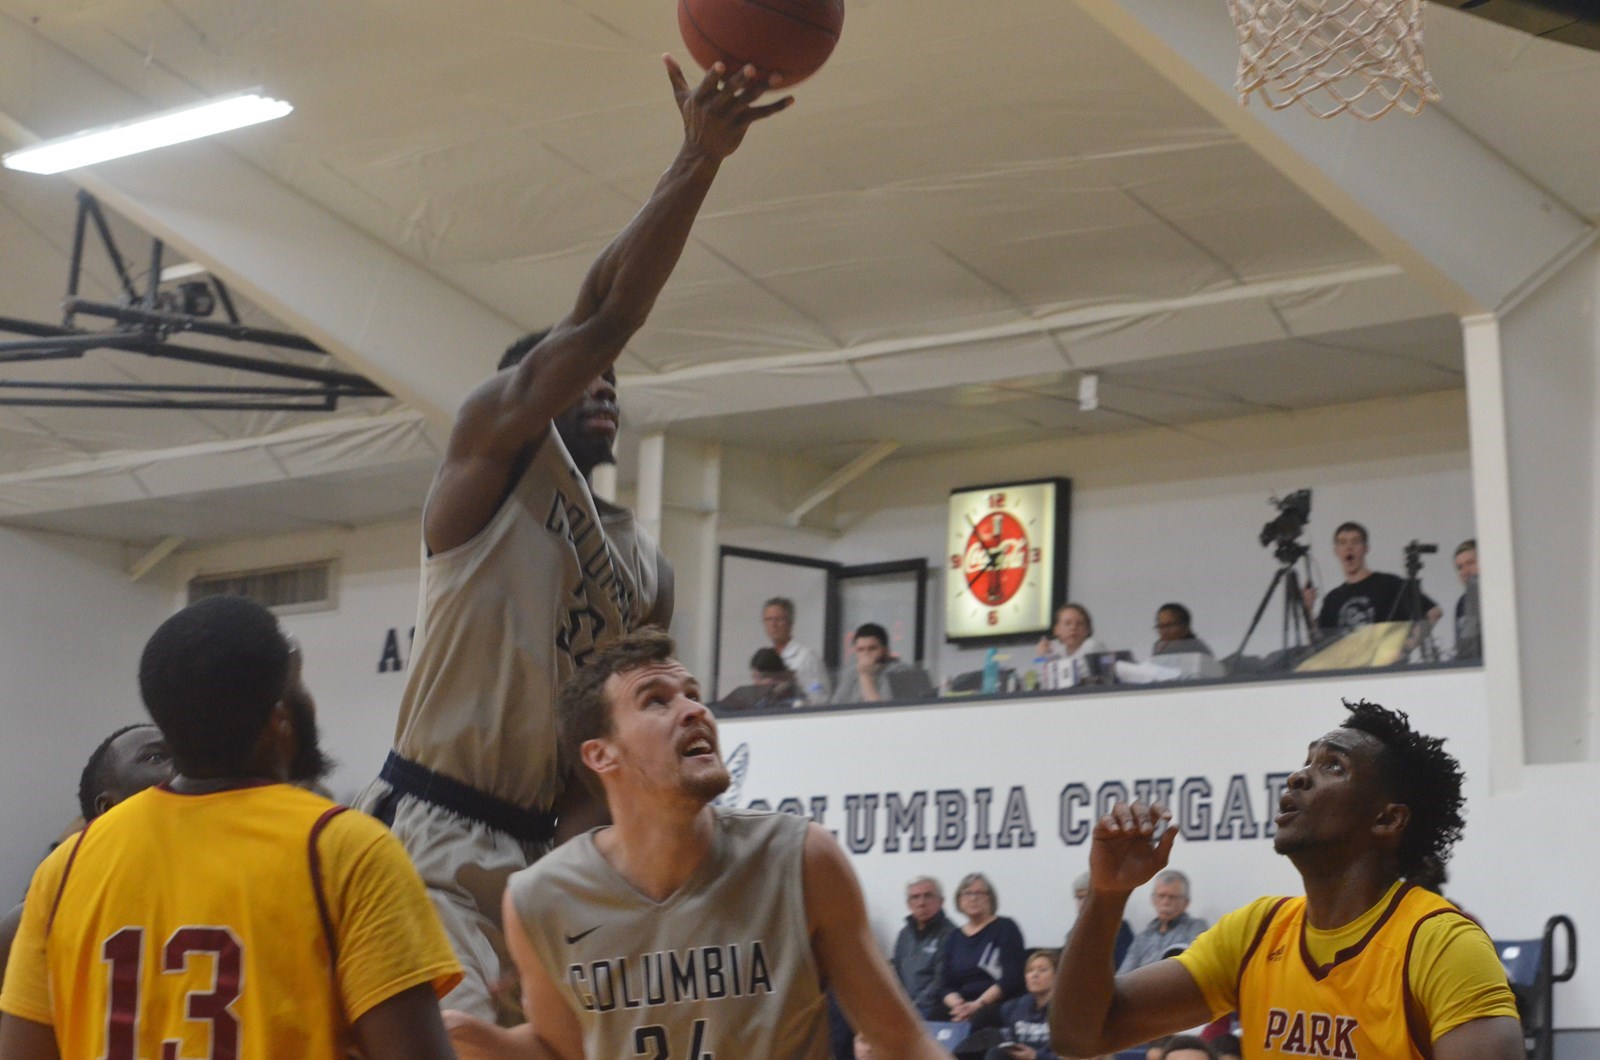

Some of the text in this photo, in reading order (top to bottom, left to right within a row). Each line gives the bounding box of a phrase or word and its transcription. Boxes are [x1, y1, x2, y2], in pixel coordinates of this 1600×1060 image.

[988, 493, 1007, 508] 12
[378, 626, 415, 673] A
[748, 785, 1035, 854] LUMBIA
[98, 925, 245, 1060] 13
[569, 940, 776, 1013] COLUMBIA
[1264, 1007, 1360, 1060] PARK
